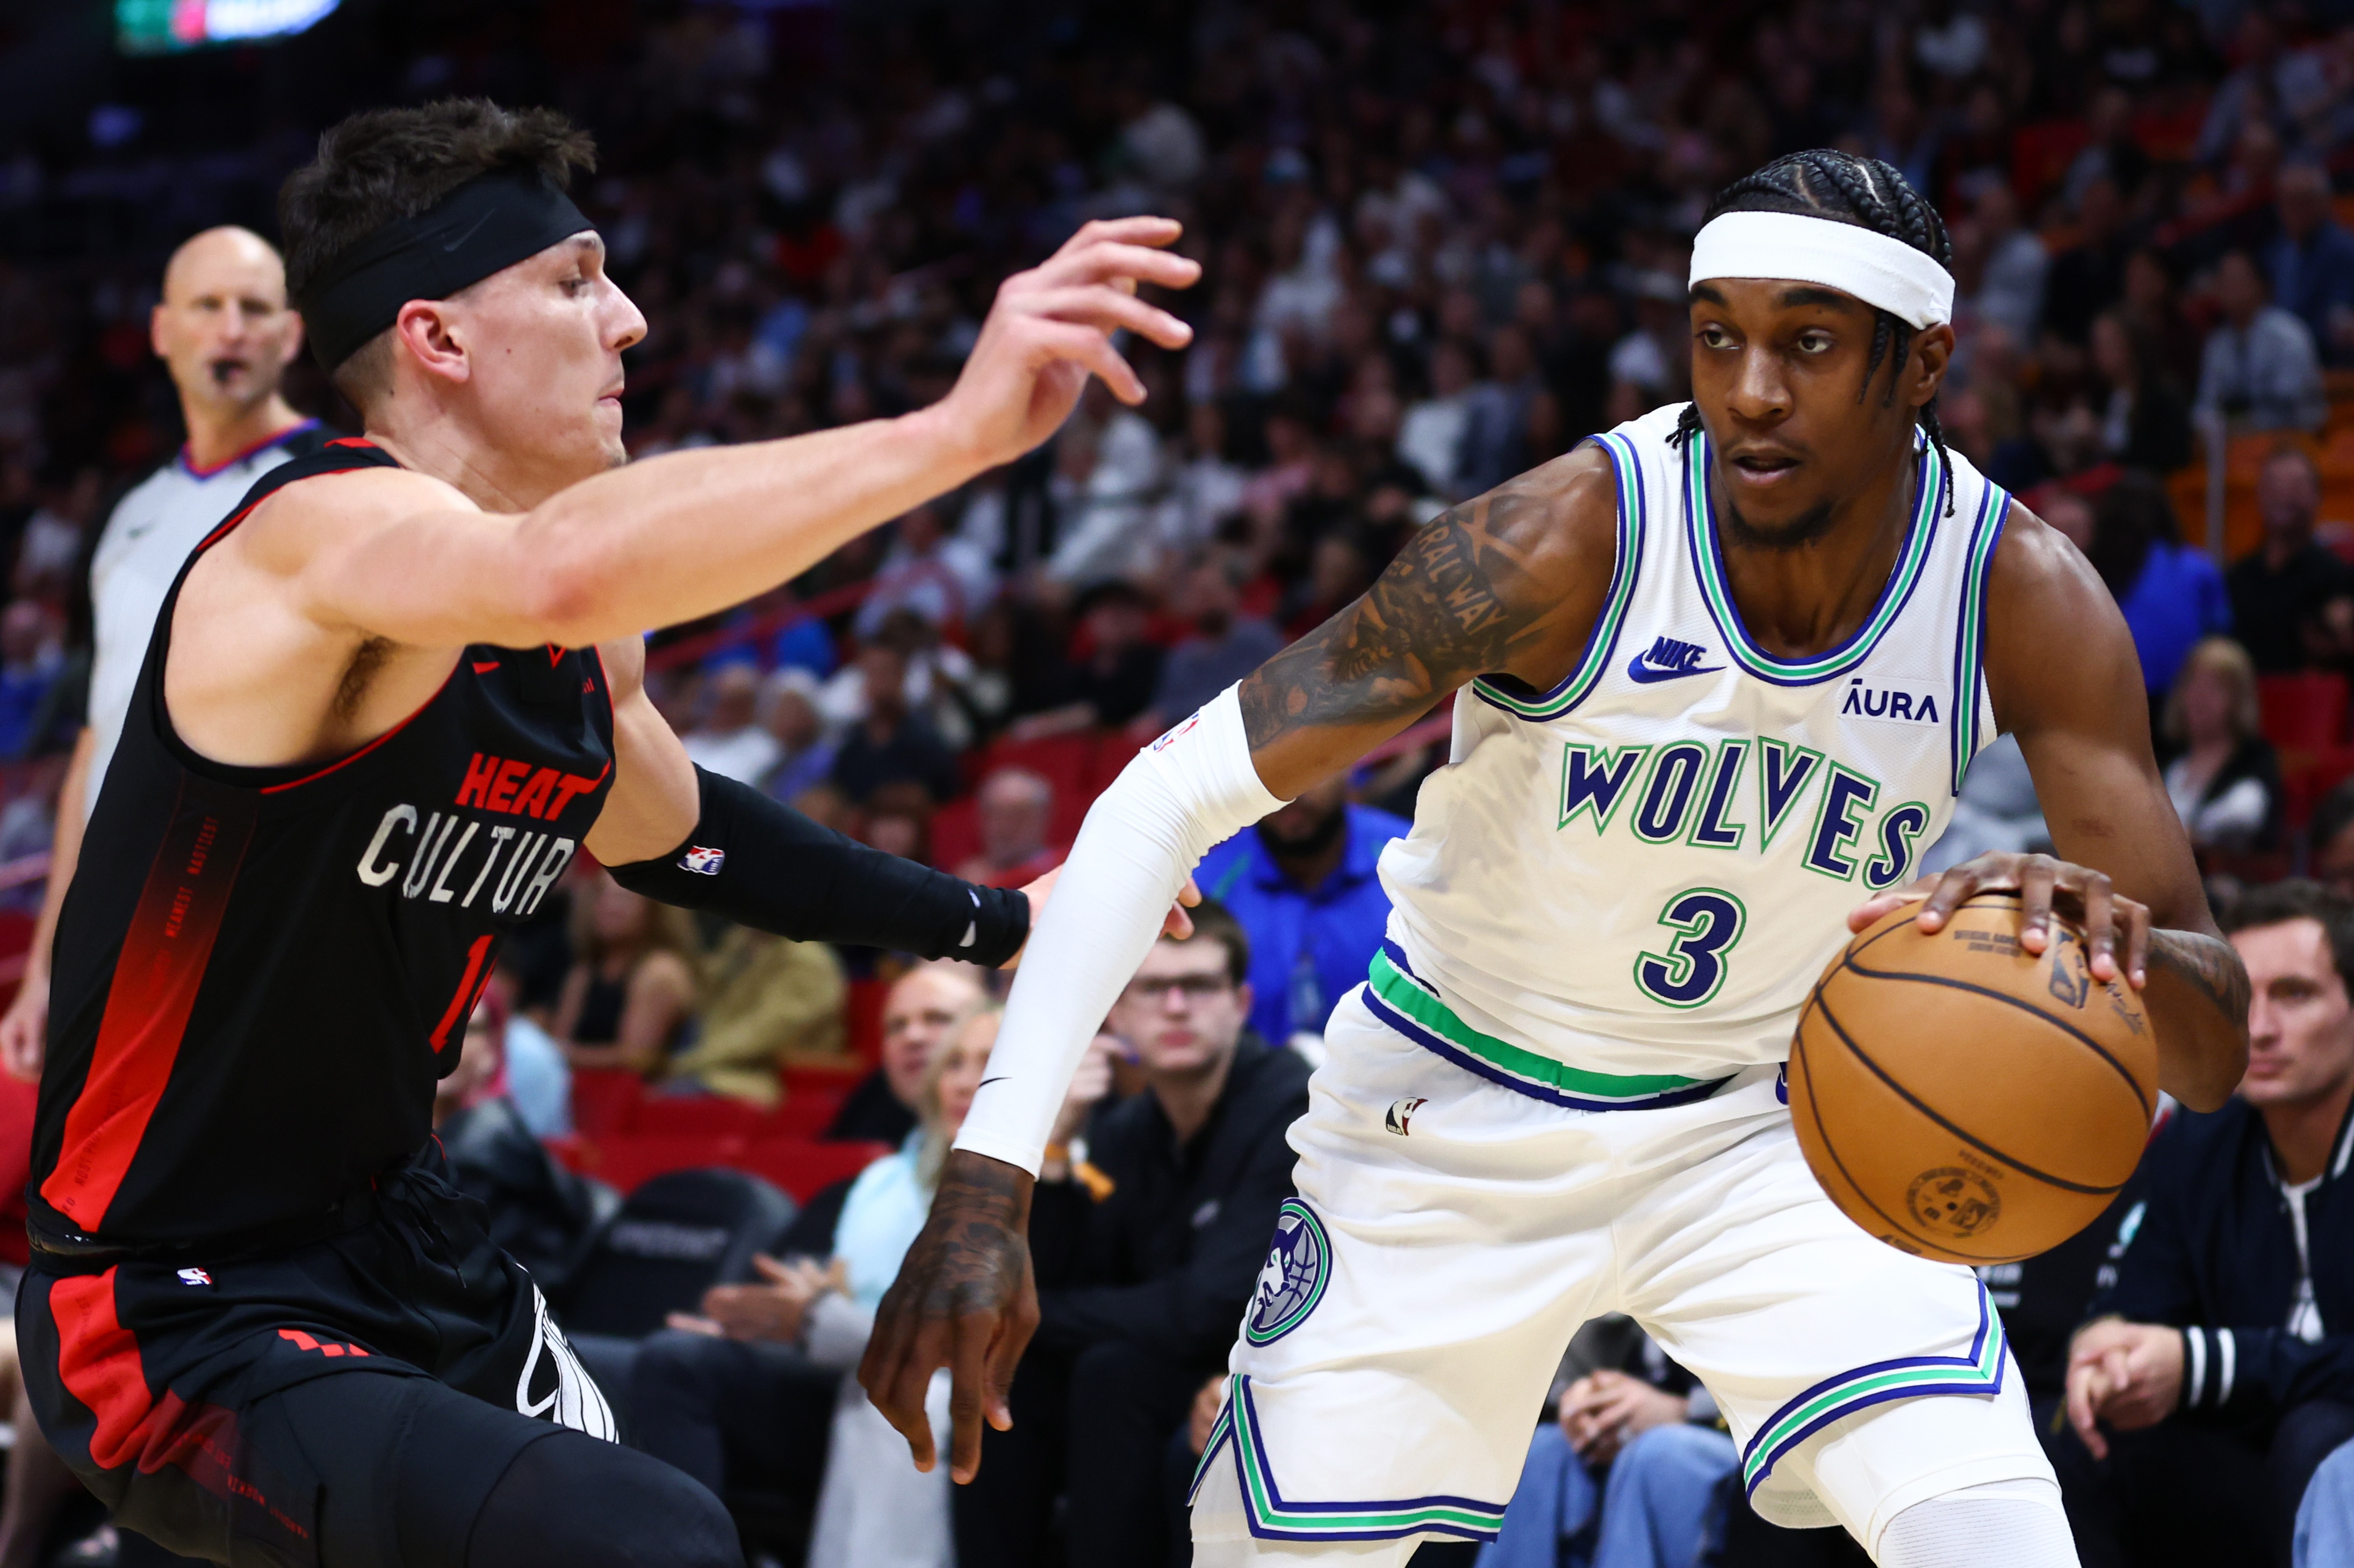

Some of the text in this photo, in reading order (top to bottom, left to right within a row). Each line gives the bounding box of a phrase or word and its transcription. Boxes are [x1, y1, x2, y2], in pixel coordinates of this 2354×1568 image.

[1445, 573, 1511, 635] WAY
[1646, 636, 1707, 670] NIKE
[455, 753, 611, 821] HEAT
[1557, 736, 1930, 891] WOLVES
[1633, 887, 1747, 1008] 3
[1387, 1124, 1402, 1135] NBA
